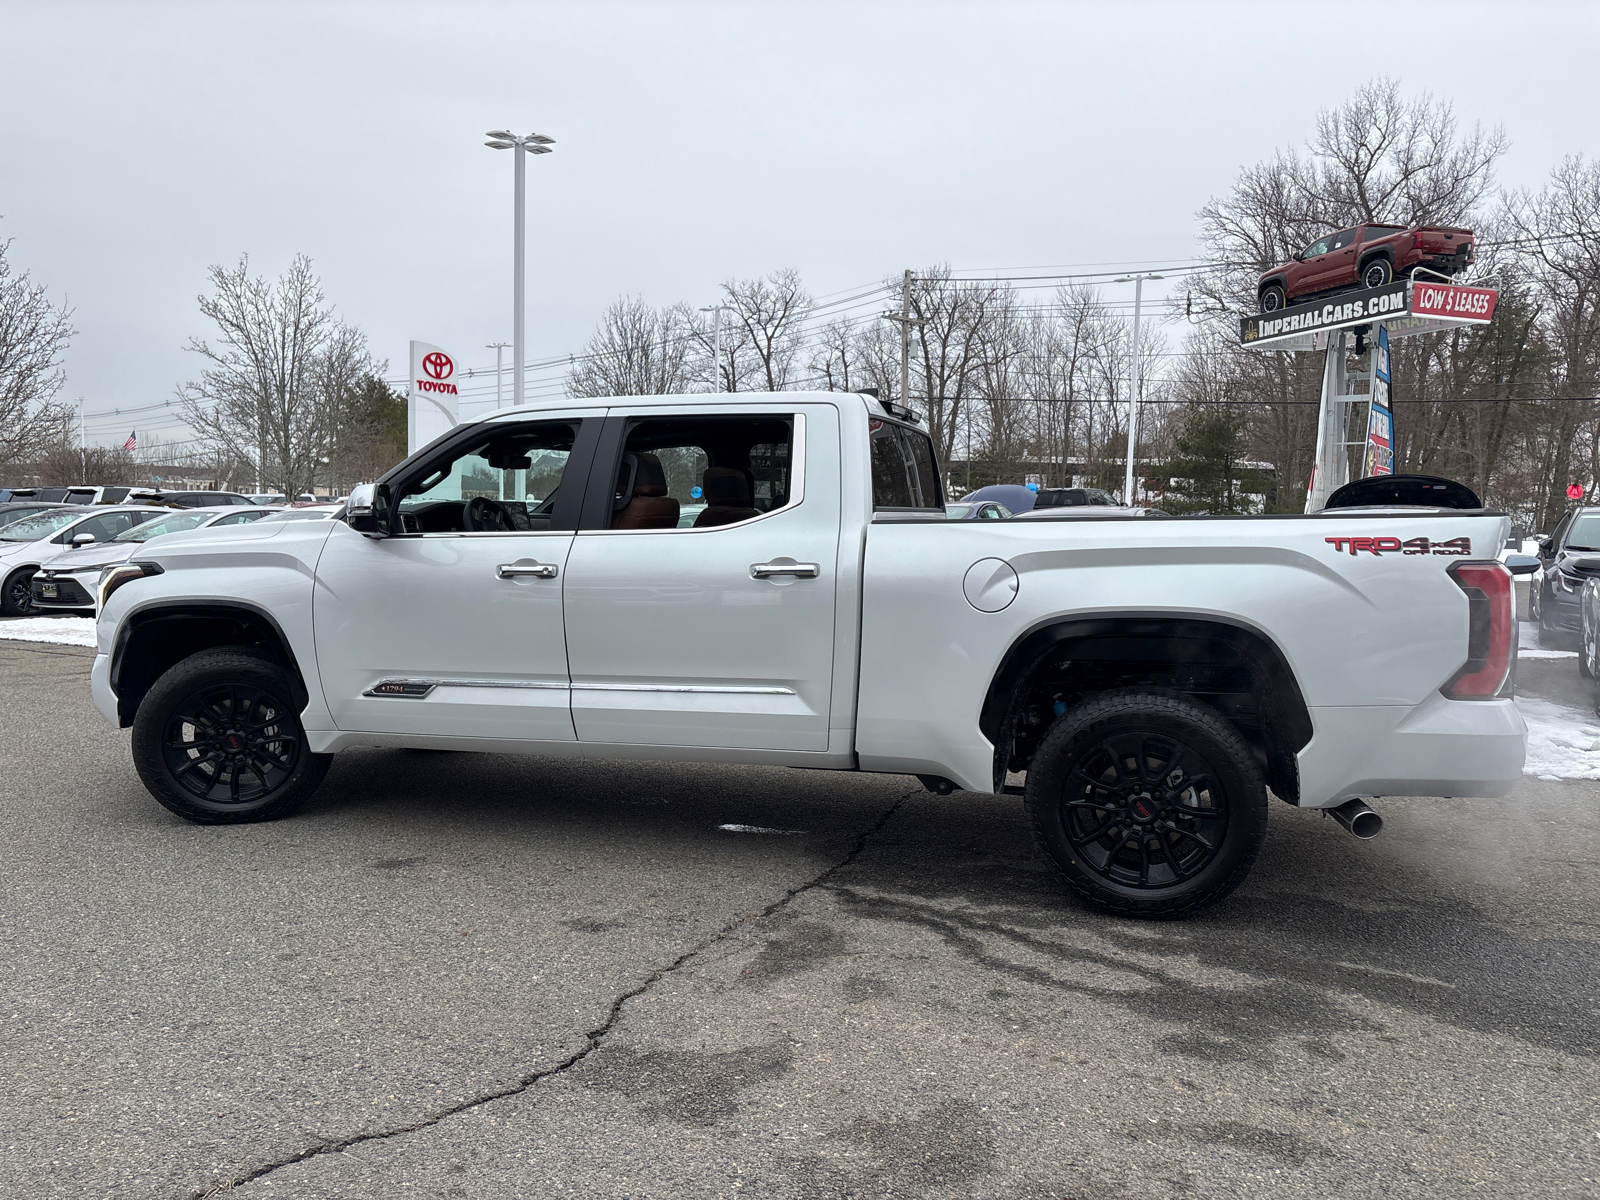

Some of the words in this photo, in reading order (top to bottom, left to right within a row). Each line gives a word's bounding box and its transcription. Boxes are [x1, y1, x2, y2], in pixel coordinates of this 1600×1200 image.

[1419, 288, 1446, 310] LOW
[1445, 288, 1454, 313] $
[1454, 291, 1491, 314] LEASES
[416, 379, 458, 395] TOYOTA
[1324, 537, 1402, 556] TRD
[386, 685, 404, 693] 1794
[1136, 801, 1150, 817] TRD
